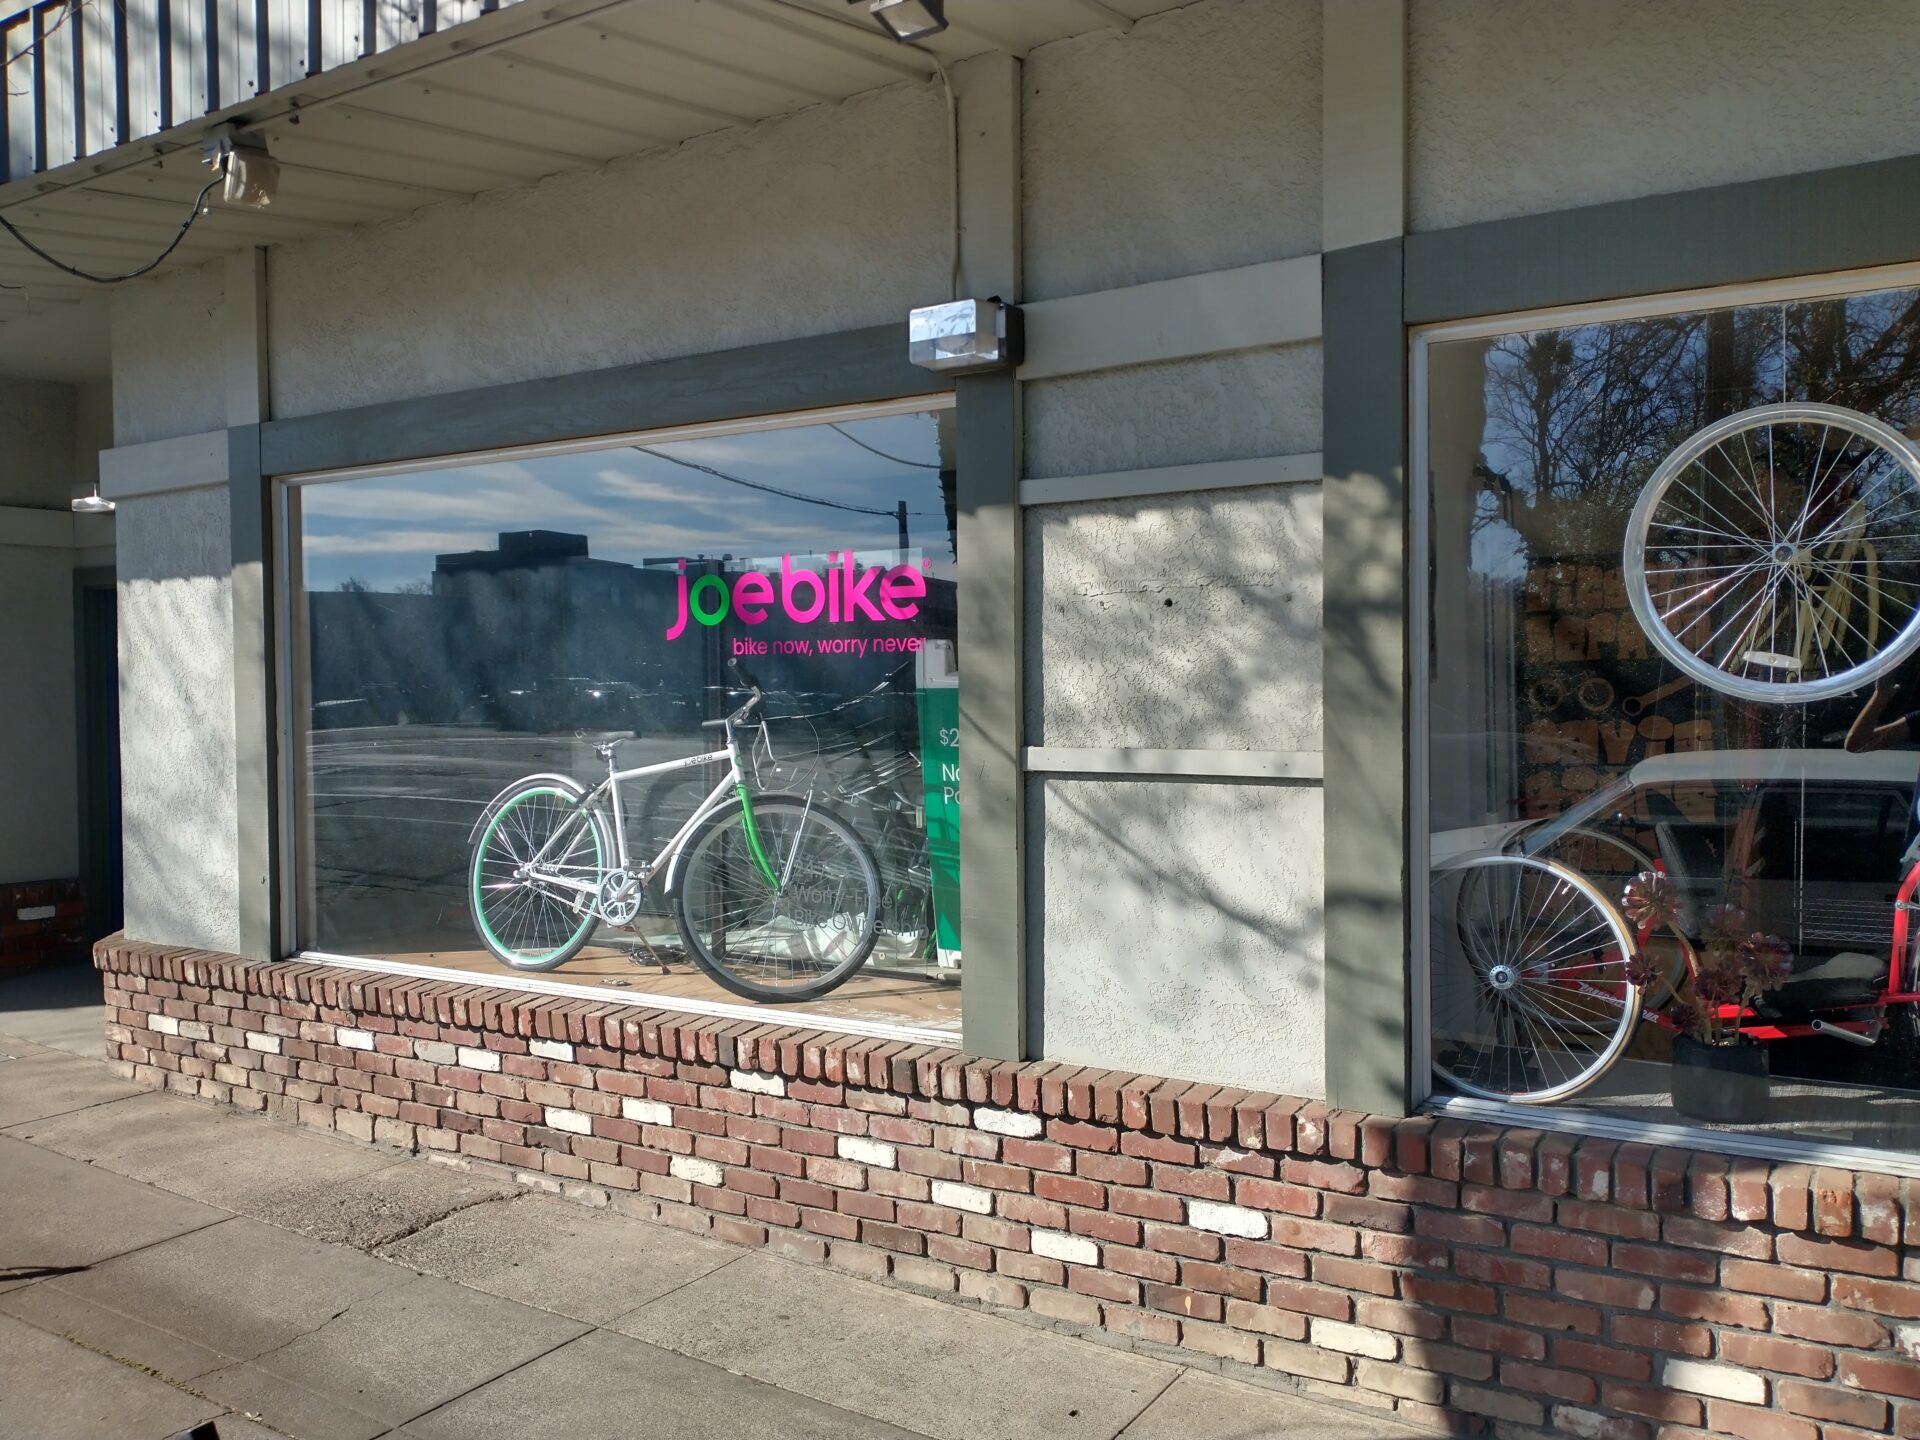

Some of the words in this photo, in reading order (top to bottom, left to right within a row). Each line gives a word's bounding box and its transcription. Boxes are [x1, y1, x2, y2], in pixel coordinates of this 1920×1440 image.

[733, 637, 768, 655] bike
[773, 639, 812, 656] now,
[817, 638, 867, 658] worry
[873, 637, 926, 654] never
[794, 910, 828, 929] Bike
